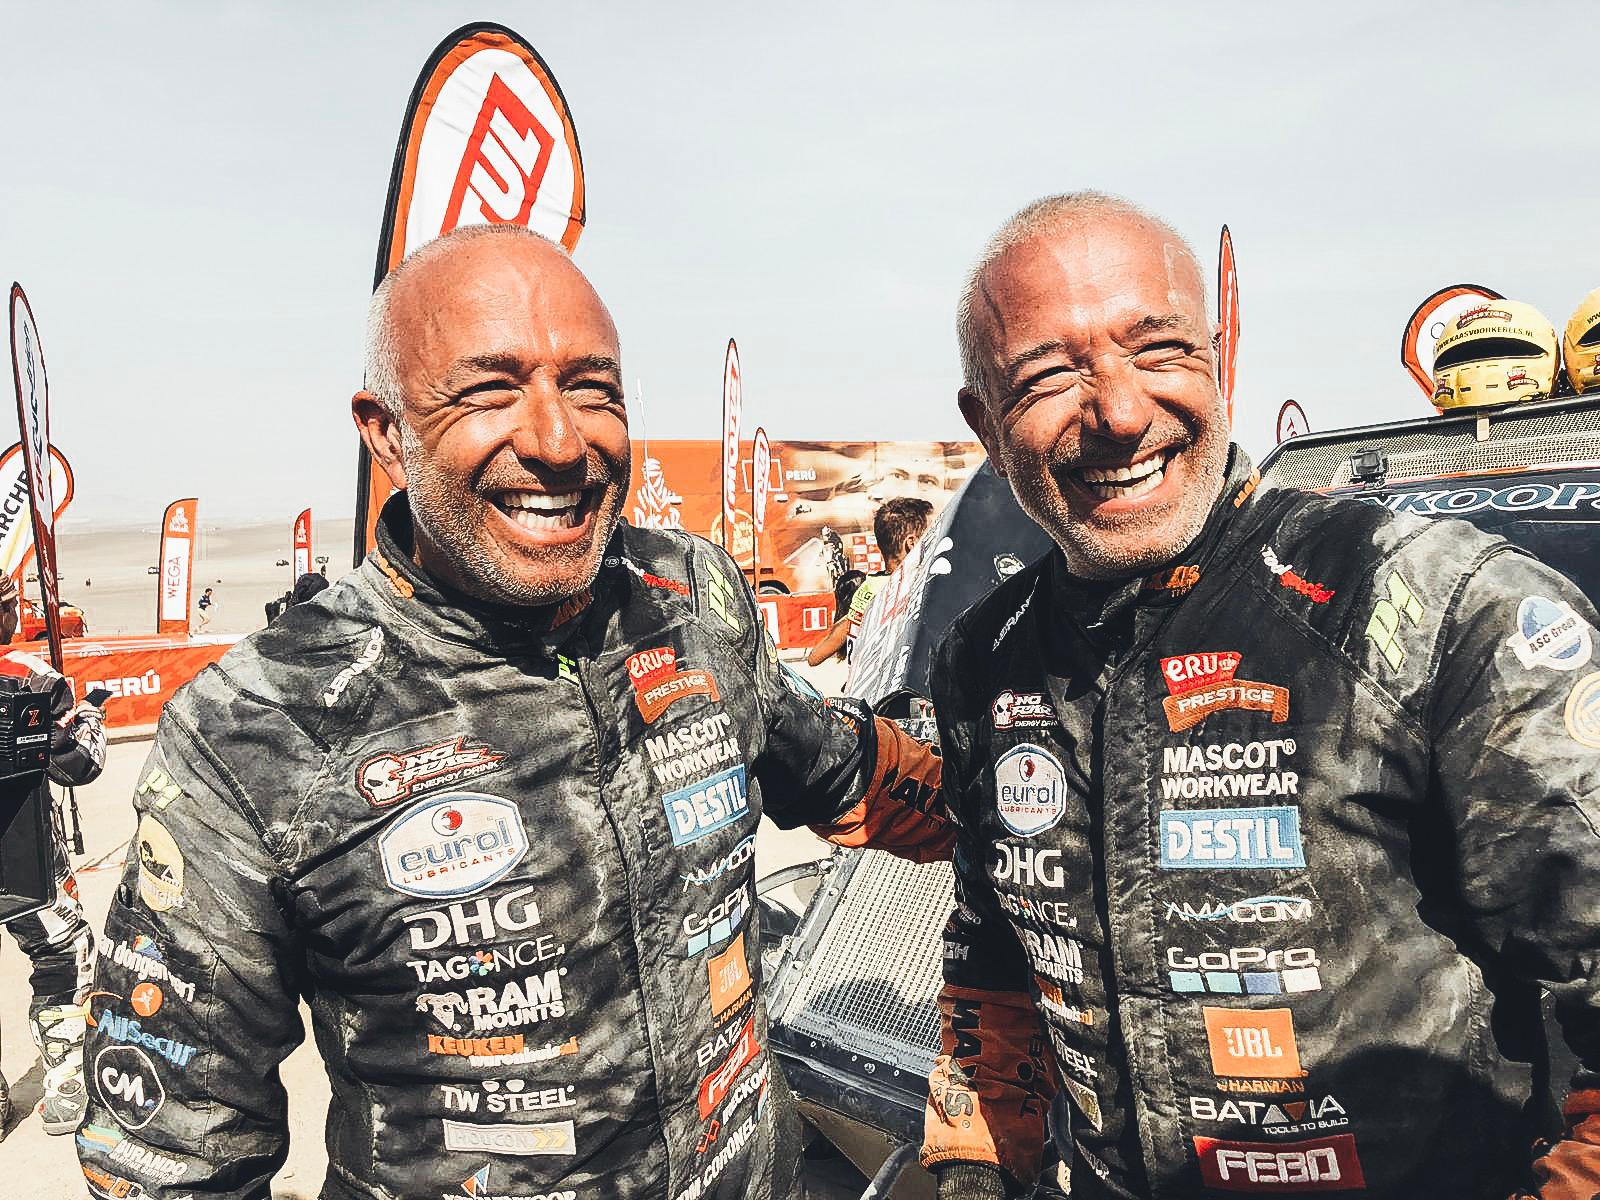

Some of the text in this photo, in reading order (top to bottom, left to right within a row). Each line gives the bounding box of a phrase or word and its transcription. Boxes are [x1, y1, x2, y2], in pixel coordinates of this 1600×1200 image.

[786, 466, 816, 480] PERÚ
[167, 555, 181, 599] WEGA
[1529, 634, 1551, 654] ASC
[86, 669, 161, 697] PERÚ
[643, 675, 709, 705] PRESTIGE
[1015, 695, 1042, 705] NO
[1177, 687, 1275, 713] PRESTIGE
[653, 738, 741, 785] WORKWEAR
[412, 761, 500, 793] ENERGY DRINK
[1161, 771, 1298, 800] WORKWEAR
[673, 776, 747, 836] DESTIL
[1001, 780, 1057, 804] eurol
[1001, 806, 1057, 815] LUBRICANTS
[399, 818, 514, 873] eurol
[1168, 818, 1293, 861] DESTIL
[403, 847, 516, 884] LUBRICANTS
[402, 885, 541, 950] DHG
[1164, 899, 1313, 923] AMACOM
[1167, 947, 1320, 970] GoPro
[719, 956, 743, 993] JBL
[473, 1000, 566, 1031] MOUNTS
[428, 1034, 524, 1057] KEUKEN
[1223, 1027, 1282, 1058] JBL
[441, 1085, 576, 1113] TW STEEL
[1229, 1079, 1304, 1093] HARMAN
[1190, 1094, 1346, 1125] BATAVIA
[1262, 1117, 1349, 1134] TOOLS TO BUILD
[1215, 1147, 1342, 1184] FEBO
